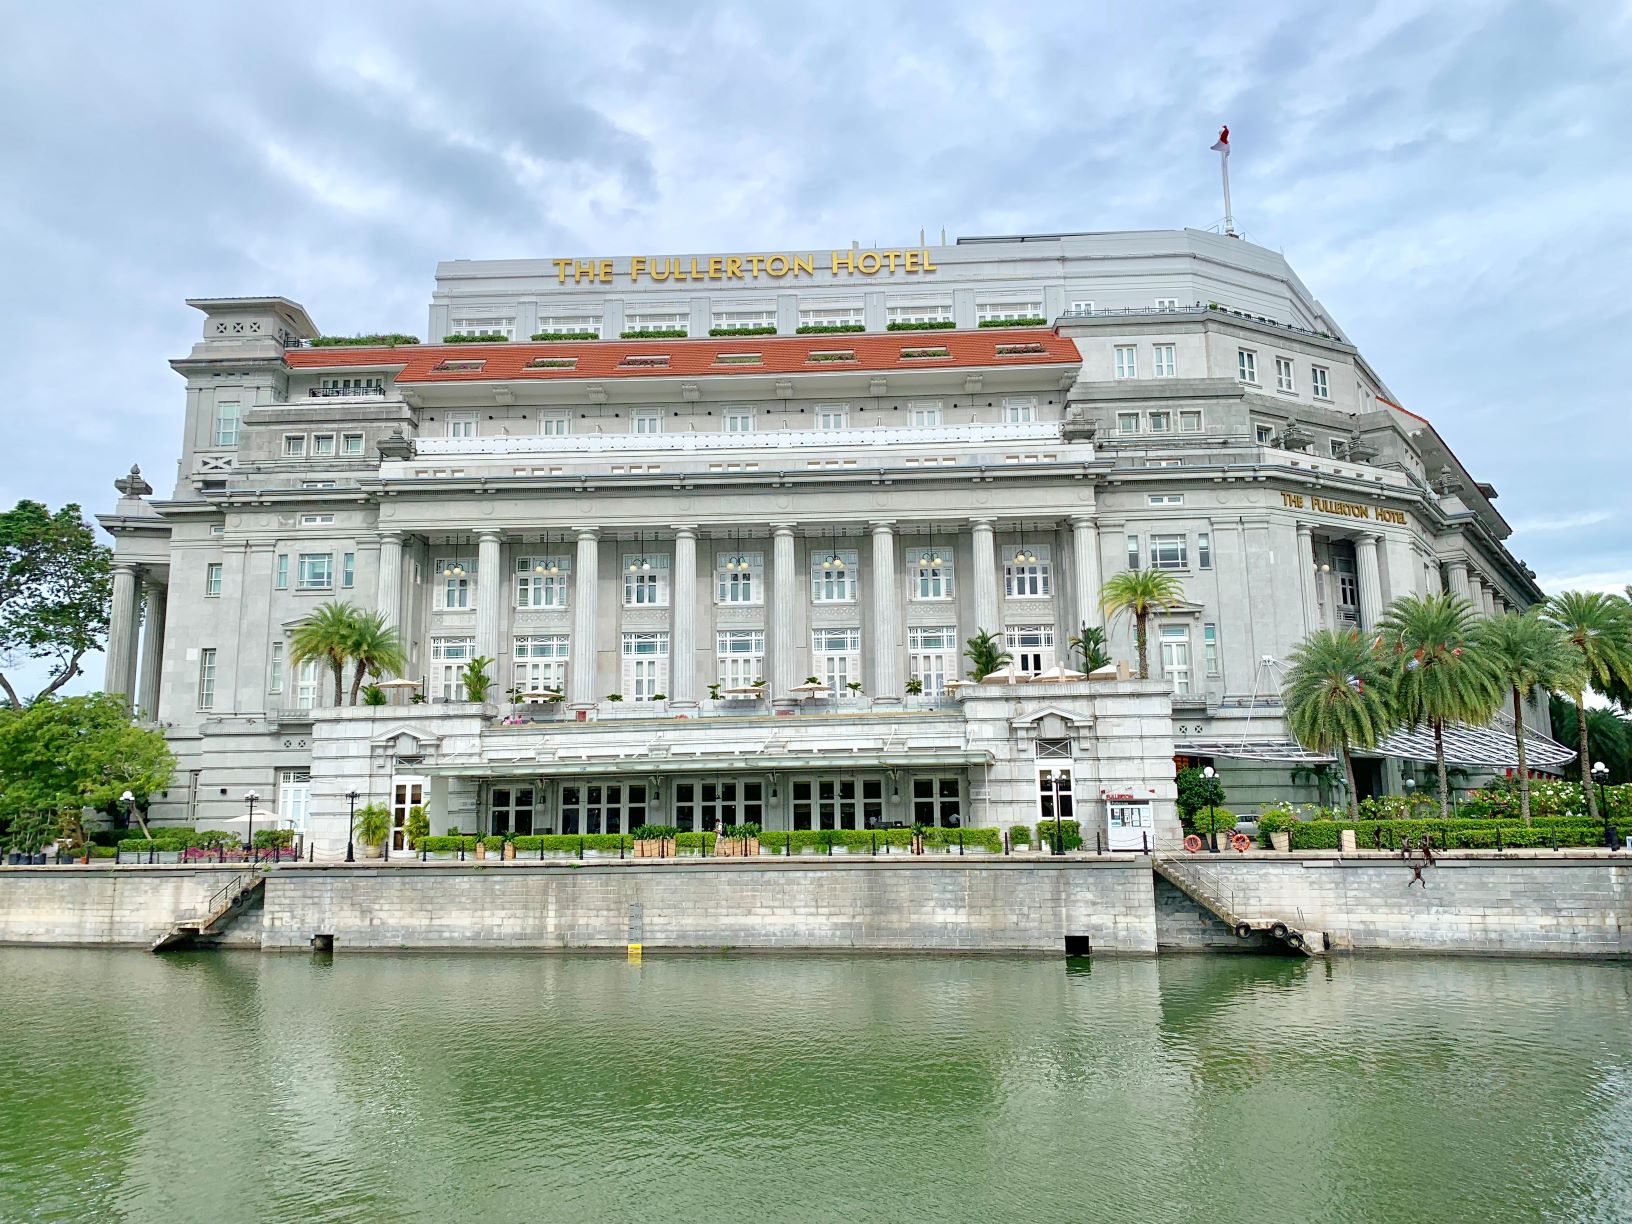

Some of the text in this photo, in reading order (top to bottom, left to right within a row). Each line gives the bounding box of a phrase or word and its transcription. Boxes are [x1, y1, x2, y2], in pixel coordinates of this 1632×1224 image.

[552, 249, 937, 283] THE FULLERTON HOTEL
[1281, 492, 1408, 525] THE FULLERTON HOTEL
